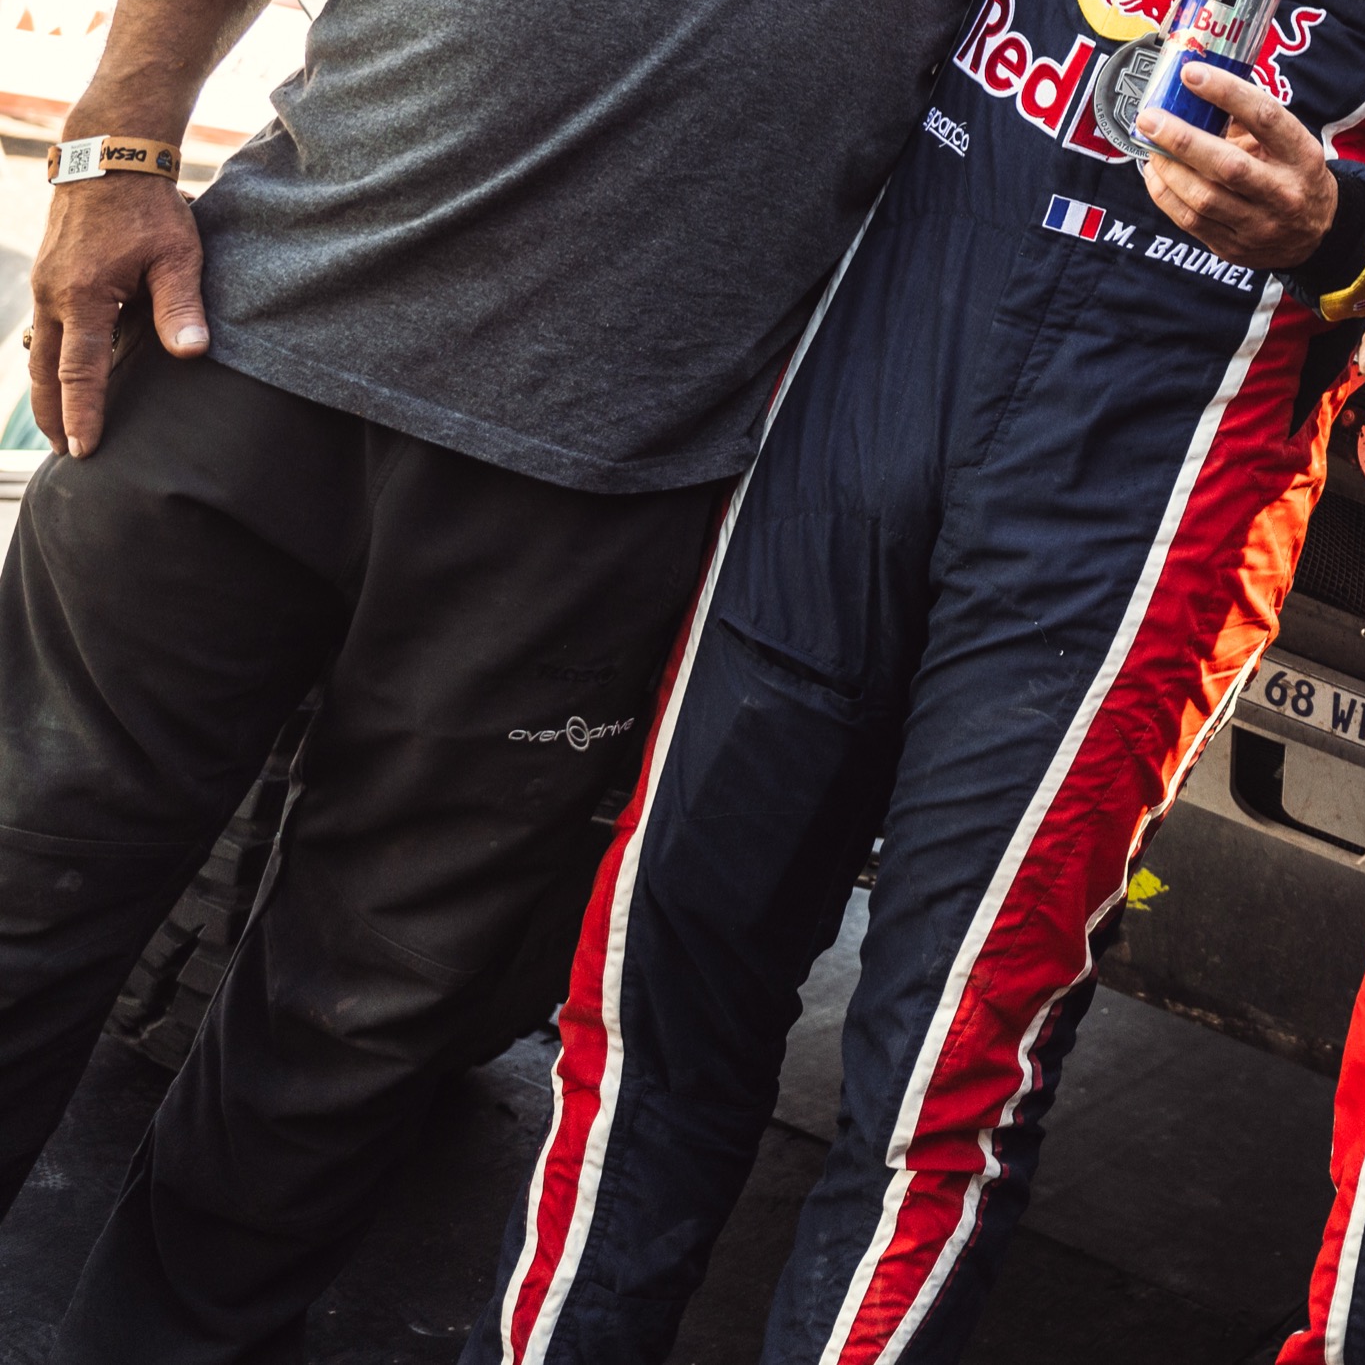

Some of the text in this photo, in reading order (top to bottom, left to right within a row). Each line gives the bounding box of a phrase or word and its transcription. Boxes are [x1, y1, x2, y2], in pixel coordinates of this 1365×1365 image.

[1193, 7, 1244, 44] Bull
[923, 106, 970, 156] sparco
[1112, 137, 1150, 158] CATAMARC
[1103, 219, 1257, 292] M. BAUMEL
[1264, 670, 1316, 718] 68
